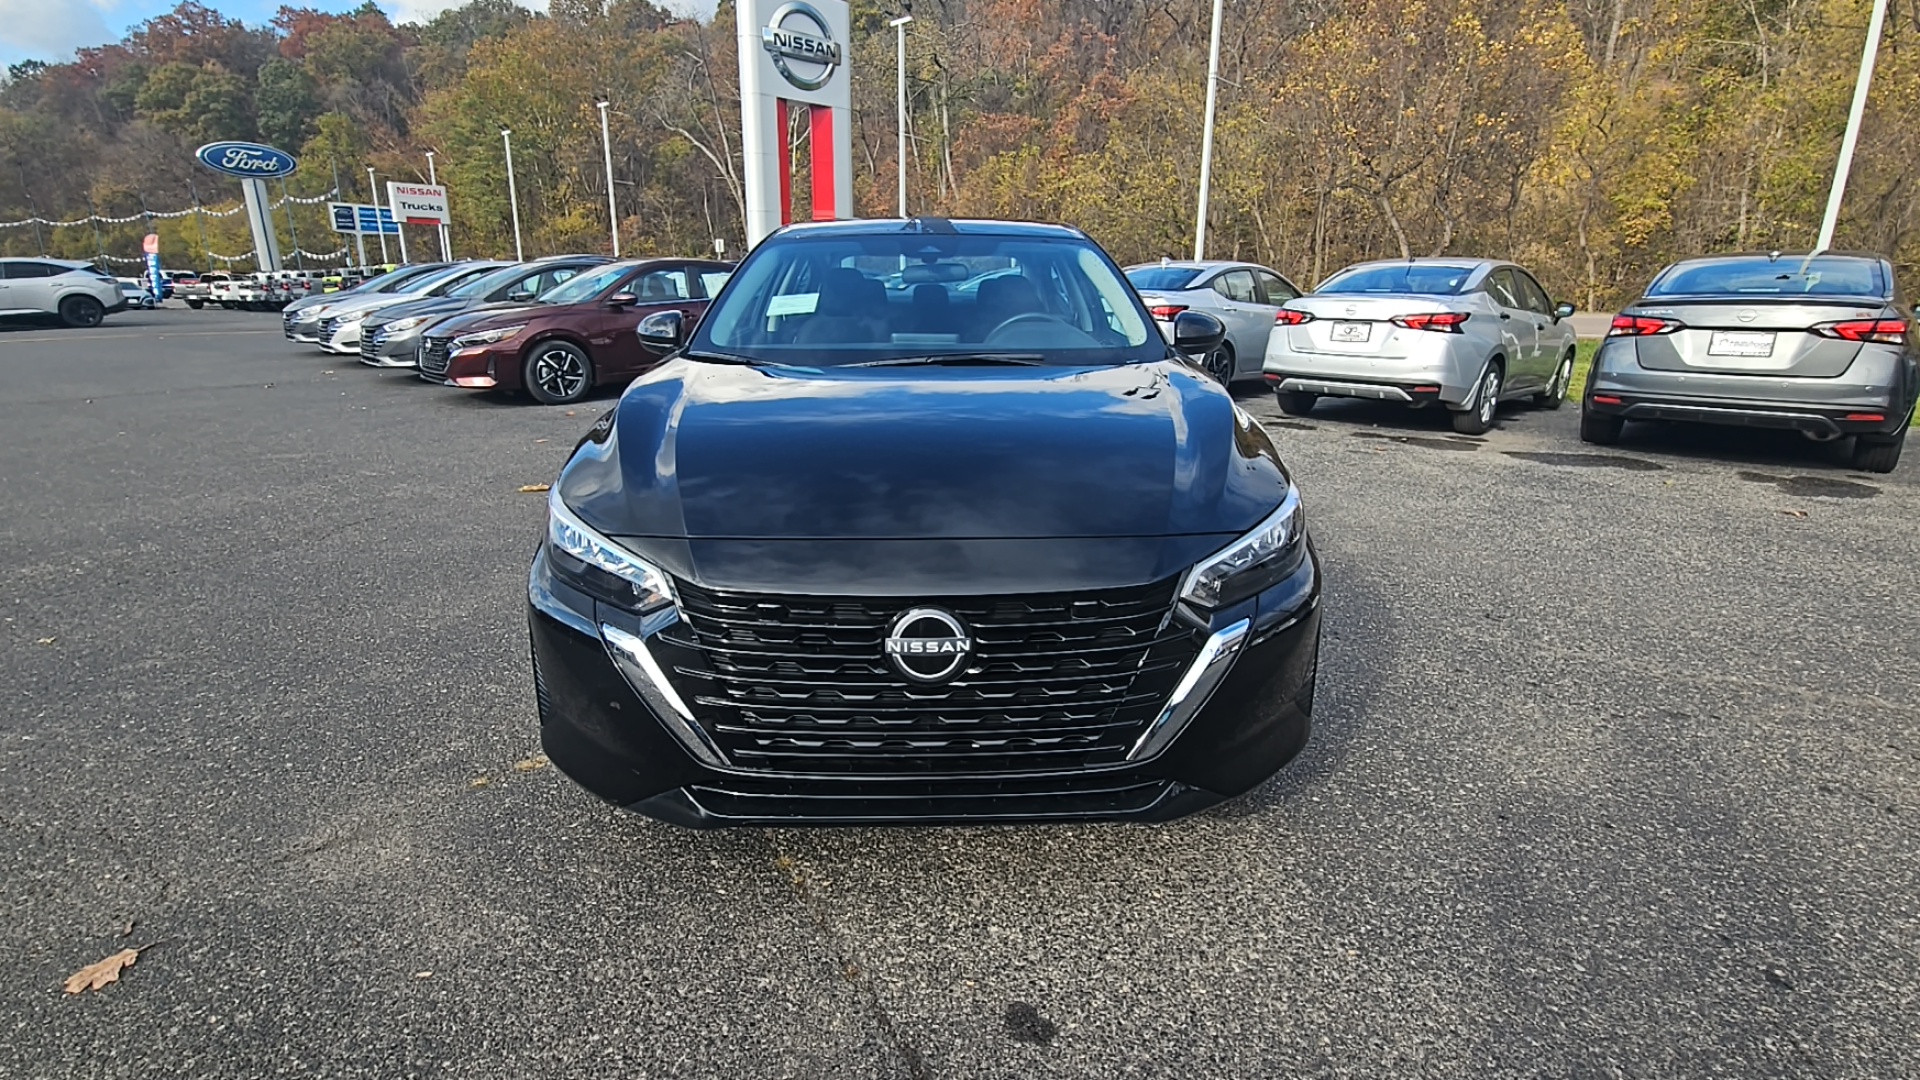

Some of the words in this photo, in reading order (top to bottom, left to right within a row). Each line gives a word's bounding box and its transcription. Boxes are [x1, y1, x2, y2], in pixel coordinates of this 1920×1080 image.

[773, 32, 836, 58] NISSAN
[222, 147, 278, 171] Ford
[396, 186, 442, 197] NISSAN
[400, 201, 443, 212] Trucks
[887, 640, 970, 653] NISSAN
